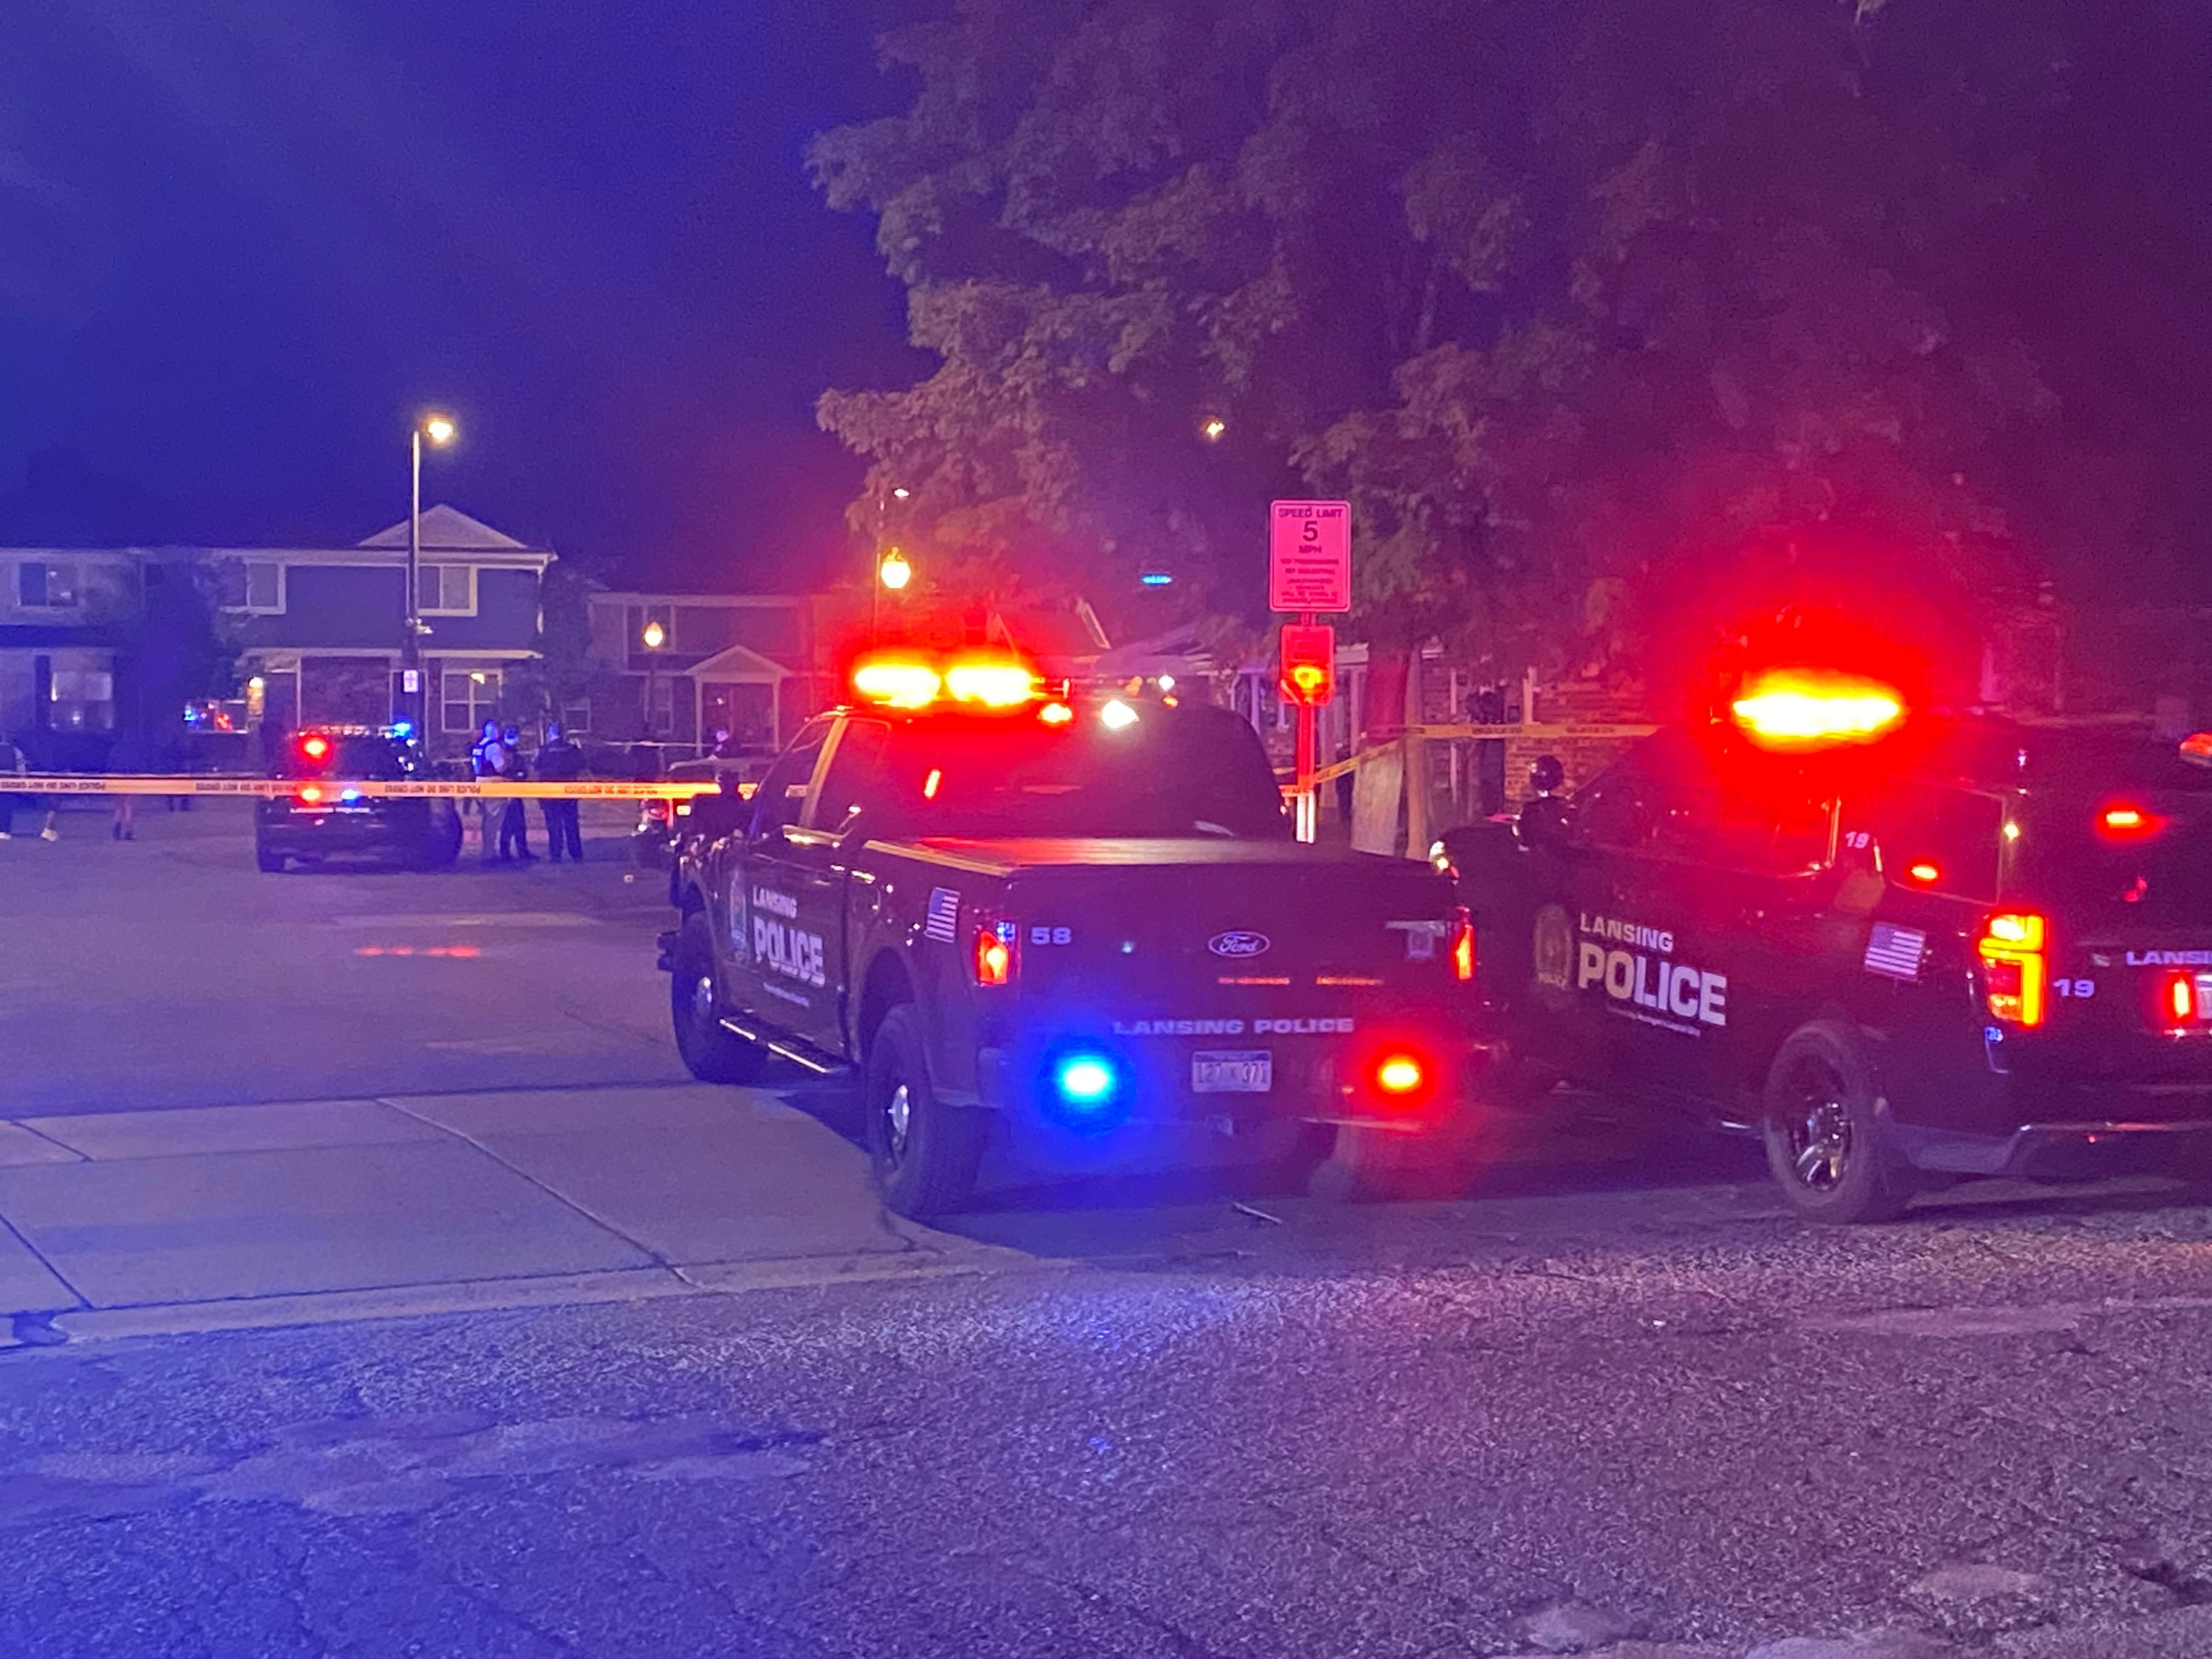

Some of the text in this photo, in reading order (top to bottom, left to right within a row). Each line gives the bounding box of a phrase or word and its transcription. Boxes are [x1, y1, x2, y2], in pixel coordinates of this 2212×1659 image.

[1279, 508, 1343, 518] SPEED LIMIT
[1303, 520, 1318, 542] 5
[1299, 545, 1322, 553] MPH
[1844, 830, 1869, 850] 19
[753, 885, 797, 919] LANSING
[1031, 926, 1072, 945] 58
[1580, 912, 1674, 953] LANSING
[754, 916, 826, 987] POLICE
[1218, 934, 1259, 953] Ford
[2126, 950, 2212, 966] LANSI
[1577, 943, 1727, 1026] POLICE
[2054, 978, 2094, 998] 19
[1114, 1019, 1244, 1035] LANSING
[1254, 1018, 1355, 1034] POLICE
